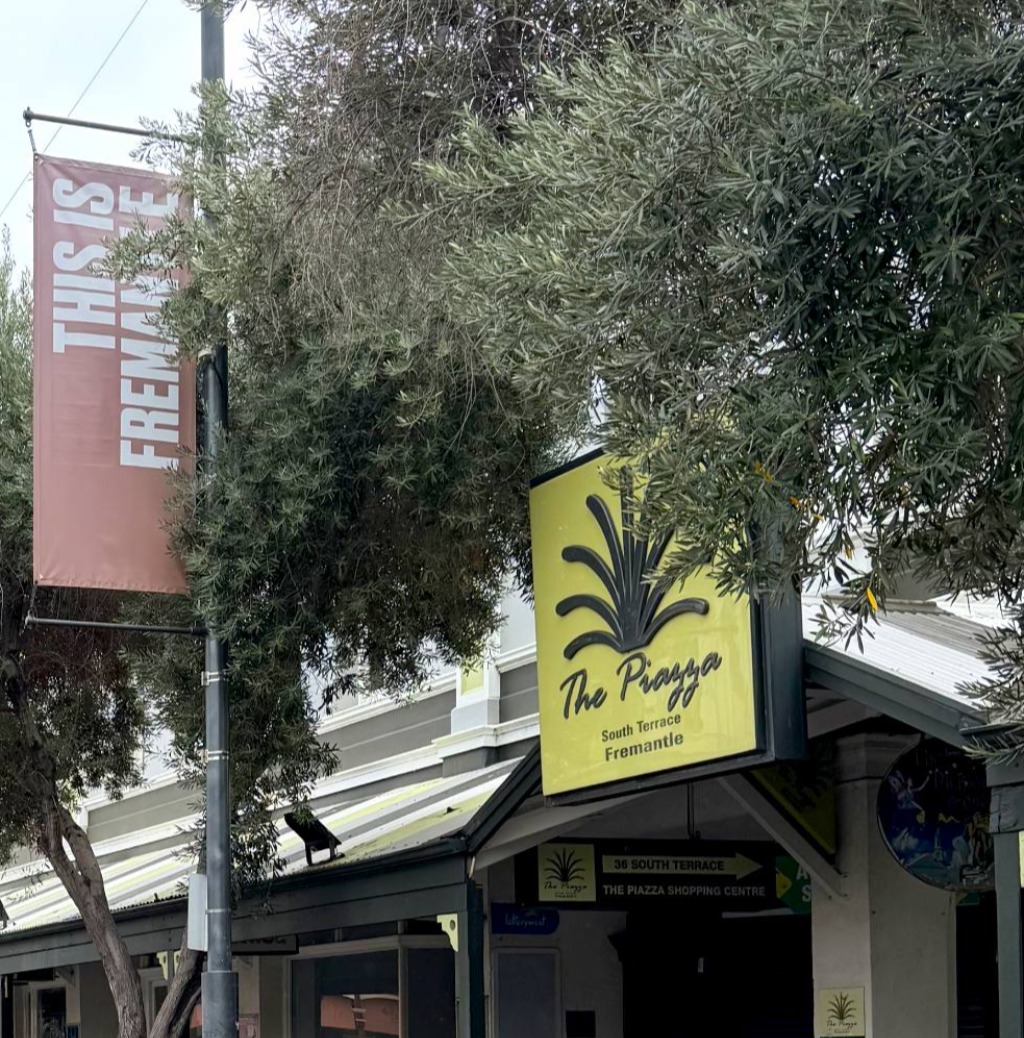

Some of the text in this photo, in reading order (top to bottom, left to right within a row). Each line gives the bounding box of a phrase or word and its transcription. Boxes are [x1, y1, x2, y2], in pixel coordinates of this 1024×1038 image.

[52, 177, 116, 354] THIS IS
[559, 651, 723, 720] The Piazza
[601, 713, 682, 743] South Terrace
[604, 731, 685, 762] Fremantle
[614, 859, 725, 871] 36 SOUTH TERRACE
[602, 884, 766, 898] THE PIAZZA SHOPPING CENTRE
